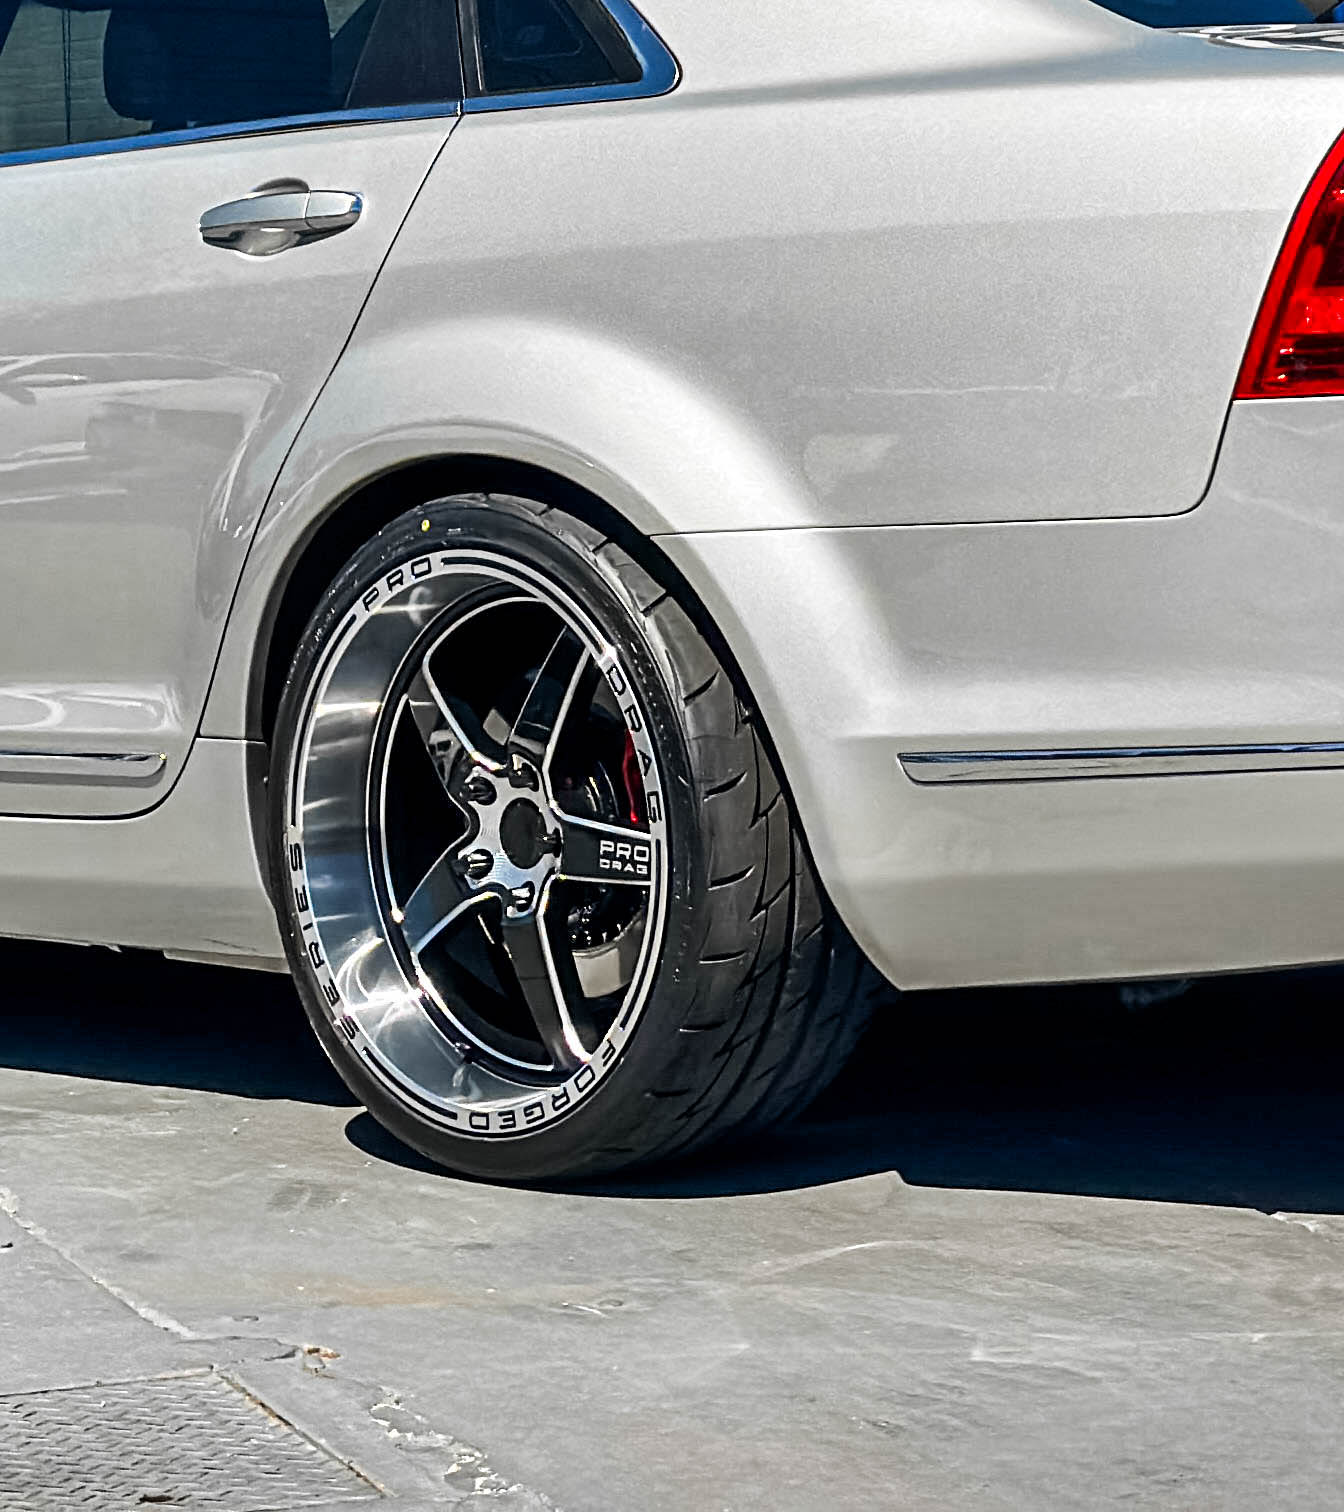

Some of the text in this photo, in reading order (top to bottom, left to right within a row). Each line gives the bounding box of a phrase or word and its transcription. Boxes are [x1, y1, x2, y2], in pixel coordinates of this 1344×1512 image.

[363, 557, 432, 612] PRO
[607, 664, 662, 824] DRAG
[599, 858, 648, 875] DRAG
[600, 840, 649, 862] PRO
[289, 842, 360, 1039] SERIES
[469, 1039, 616, 1130] FORGED
